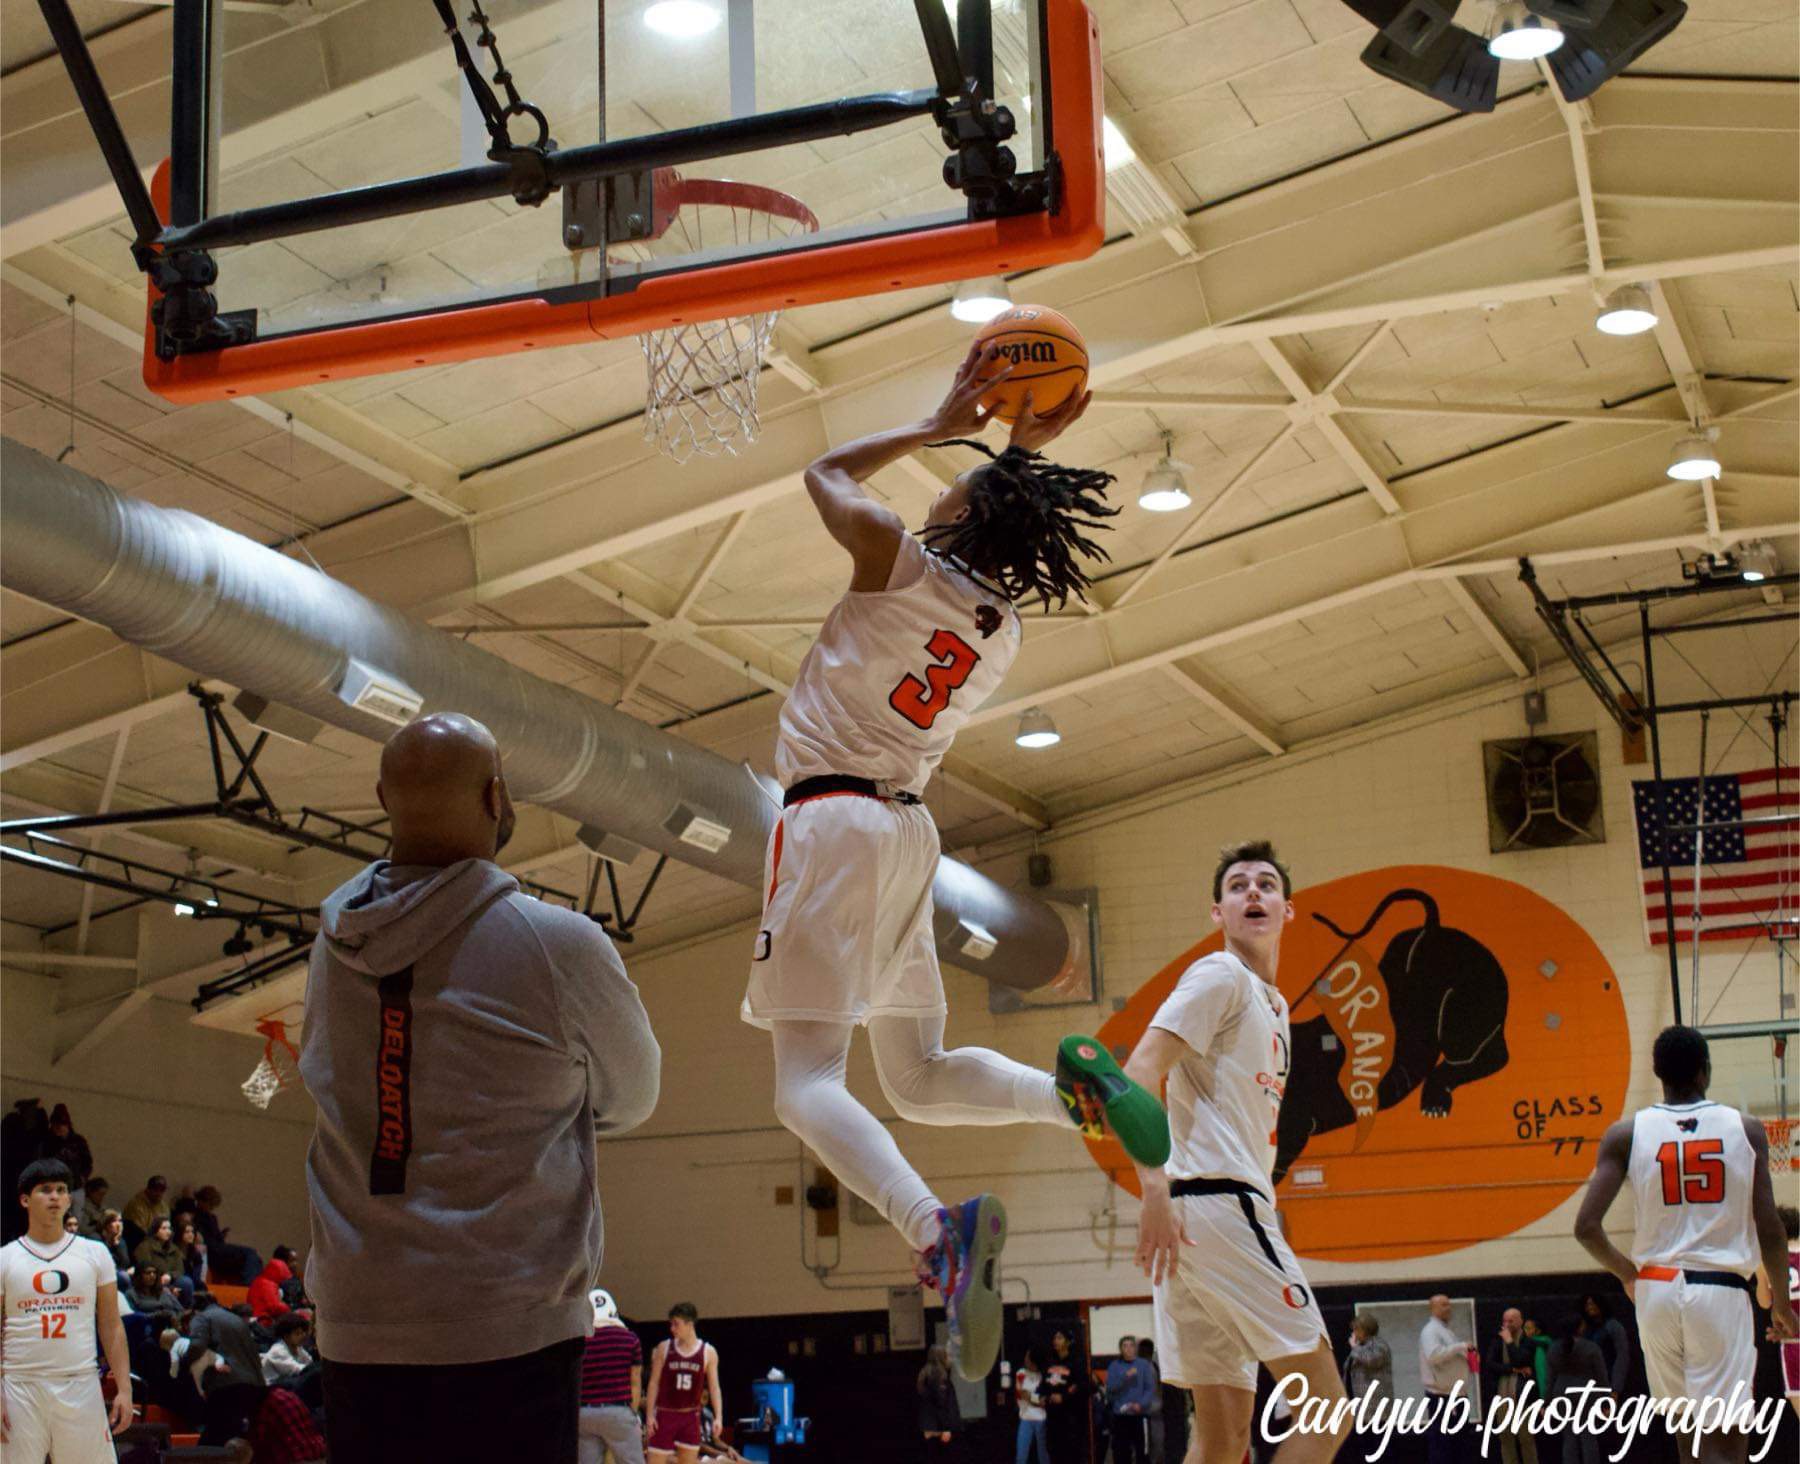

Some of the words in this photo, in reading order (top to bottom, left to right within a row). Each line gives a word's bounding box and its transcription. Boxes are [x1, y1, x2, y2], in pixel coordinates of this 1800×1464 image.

[888, 628, 982, 730] 3
[1325, 960, 1386, 1117] ORANGE
[379, 1006, 406, 1162] DELOATCH
[1513, 1095, 1603, 1120] CLASS
[1517, 1119, 1546, 1139] OF
[1549, 1136, 1584, 1156] 77
[1655, 1138, 1726, 1206] 15
[17, 1296, 86, 1310] ORANGE
[41, 1313, 67, 1339] 12
[676, 1373, 692, 1390] 15
